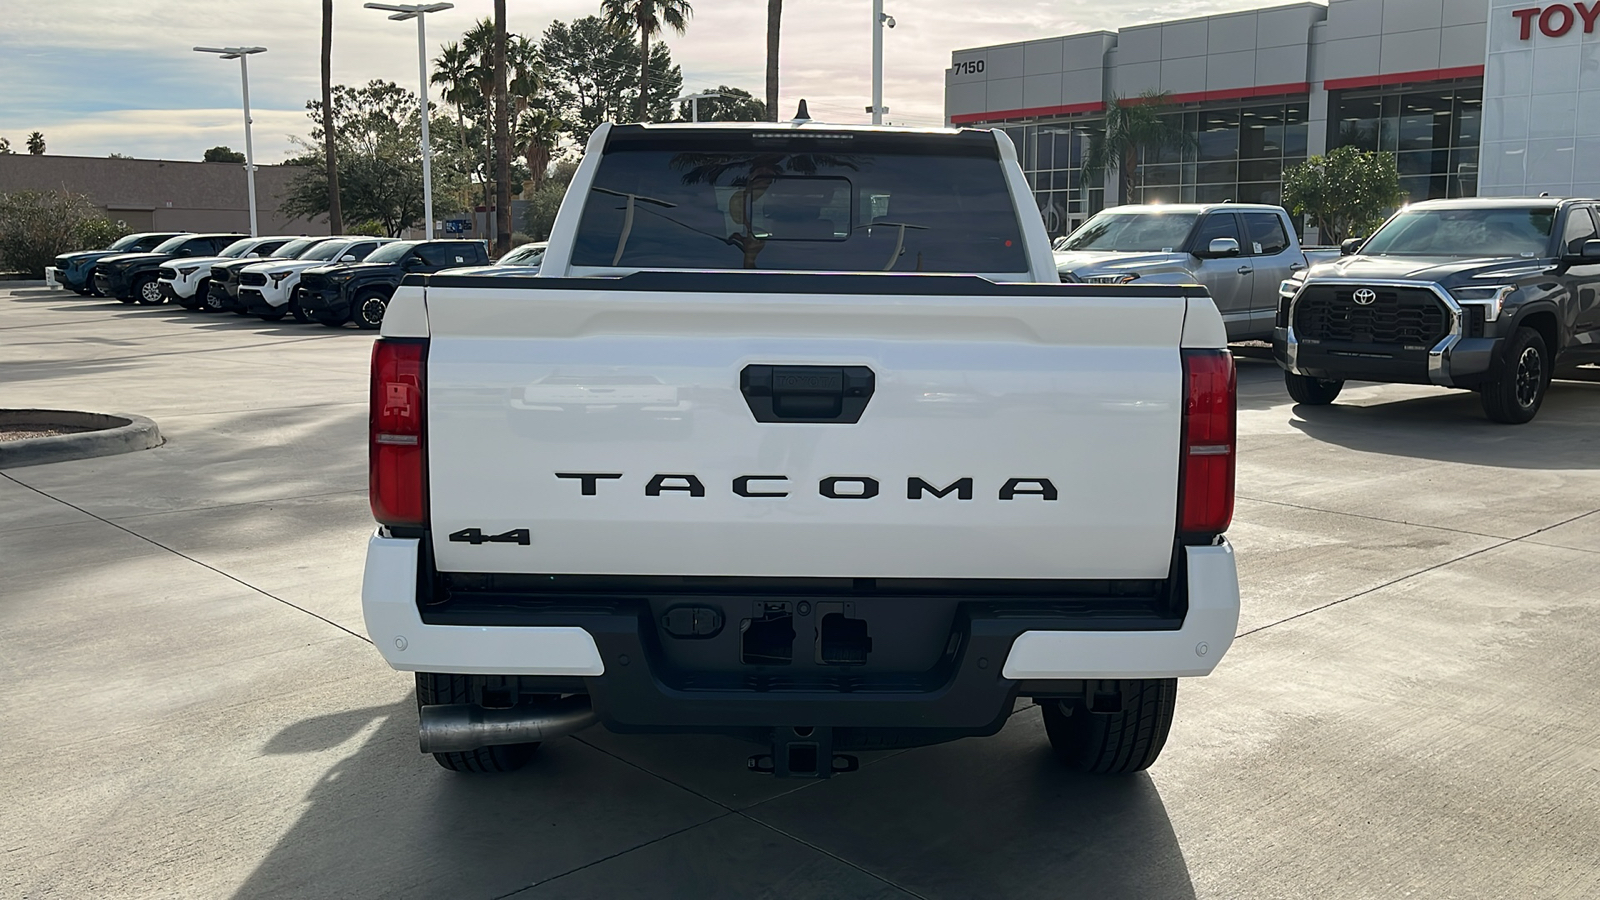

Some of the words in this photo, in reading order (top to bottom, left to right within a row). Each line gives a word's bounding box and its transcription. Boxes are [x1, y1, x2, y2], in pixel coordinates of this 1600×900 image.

[953, 60, 985, 76] 7150
[775, 375, 838, 388] TOYOTA
[554, 472, 1058, 501] TACOMA
